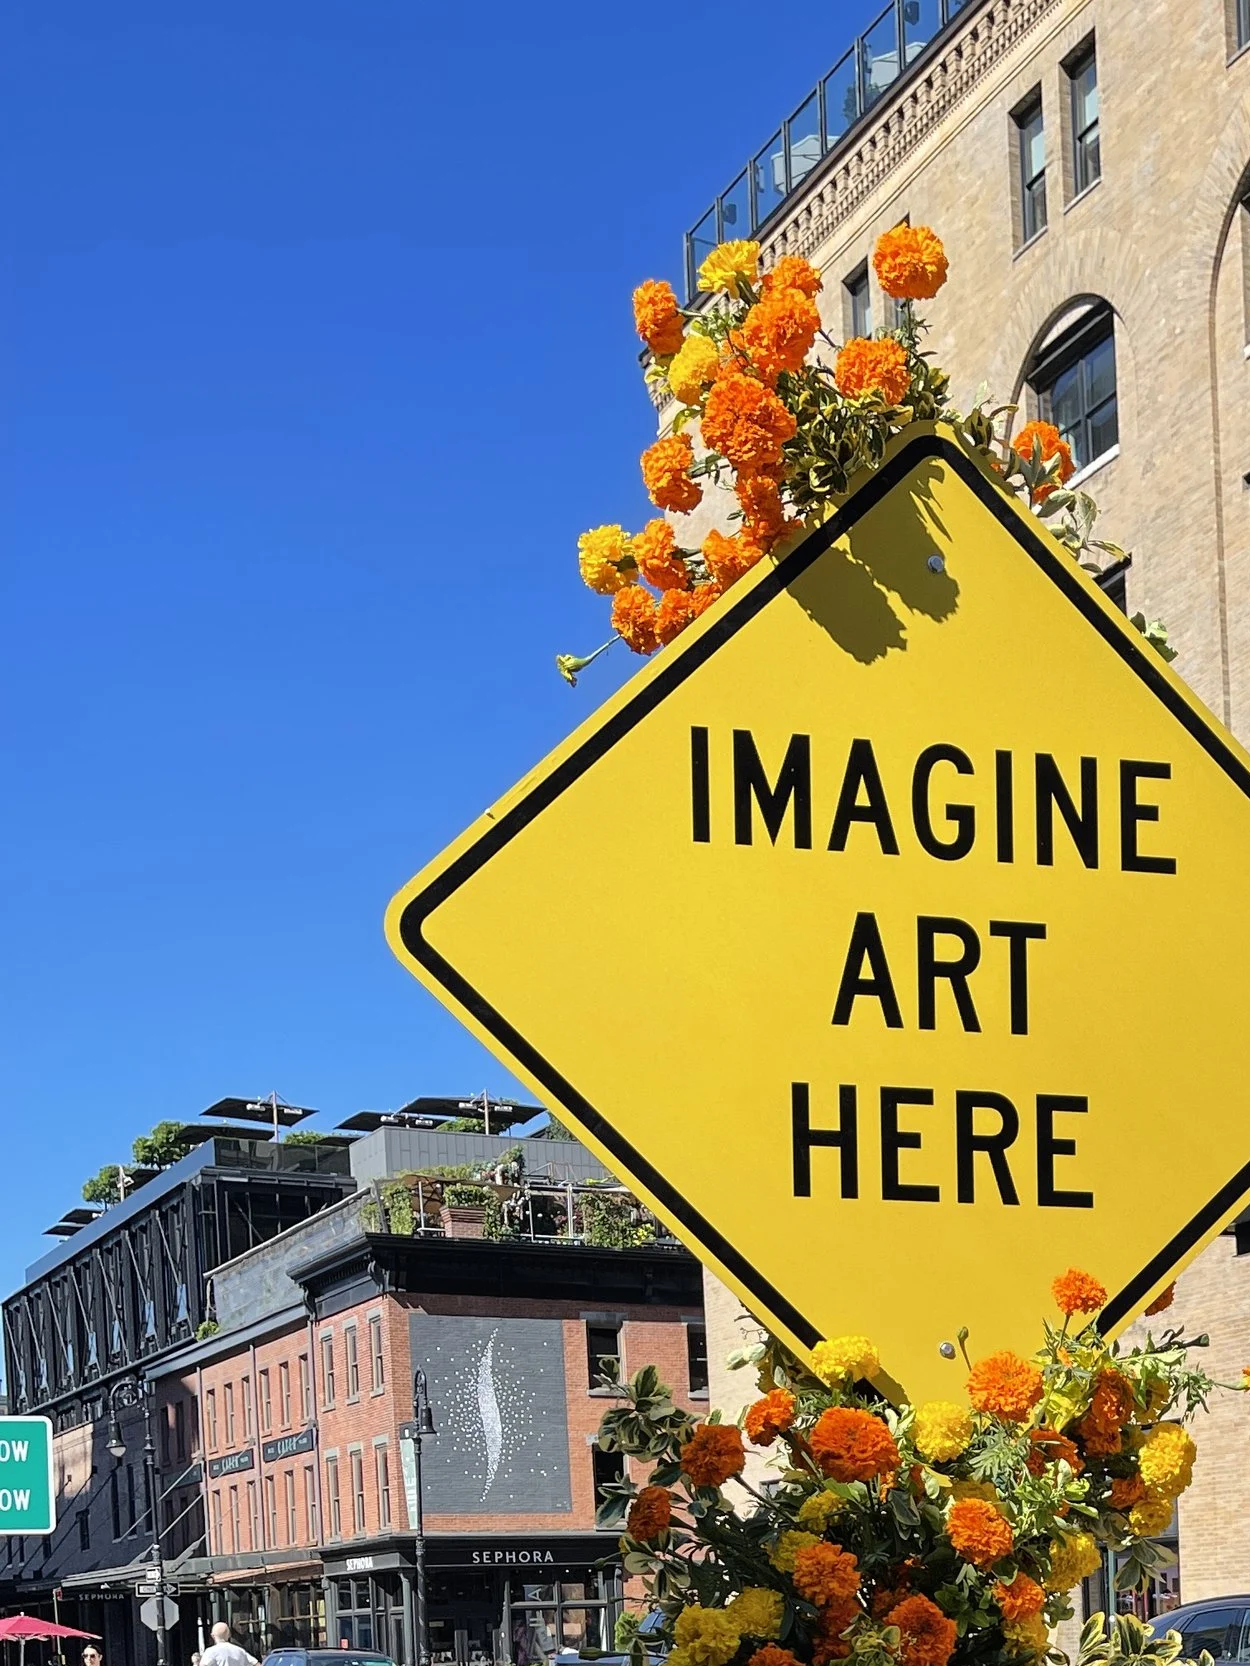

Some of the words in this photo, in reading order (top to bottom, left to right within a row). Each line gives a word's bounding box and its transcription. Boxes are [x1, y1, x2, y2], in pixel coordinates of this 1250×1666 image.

[690, 725, 1177, 875] IMAGINE
[831, 911, 1047, 1036] ART
[791, 1081, 1094, 1209] HERE
[346, 1556, 374, 1571] SEPHORA
[472, 1550, 554, 1563] SEPHORA
